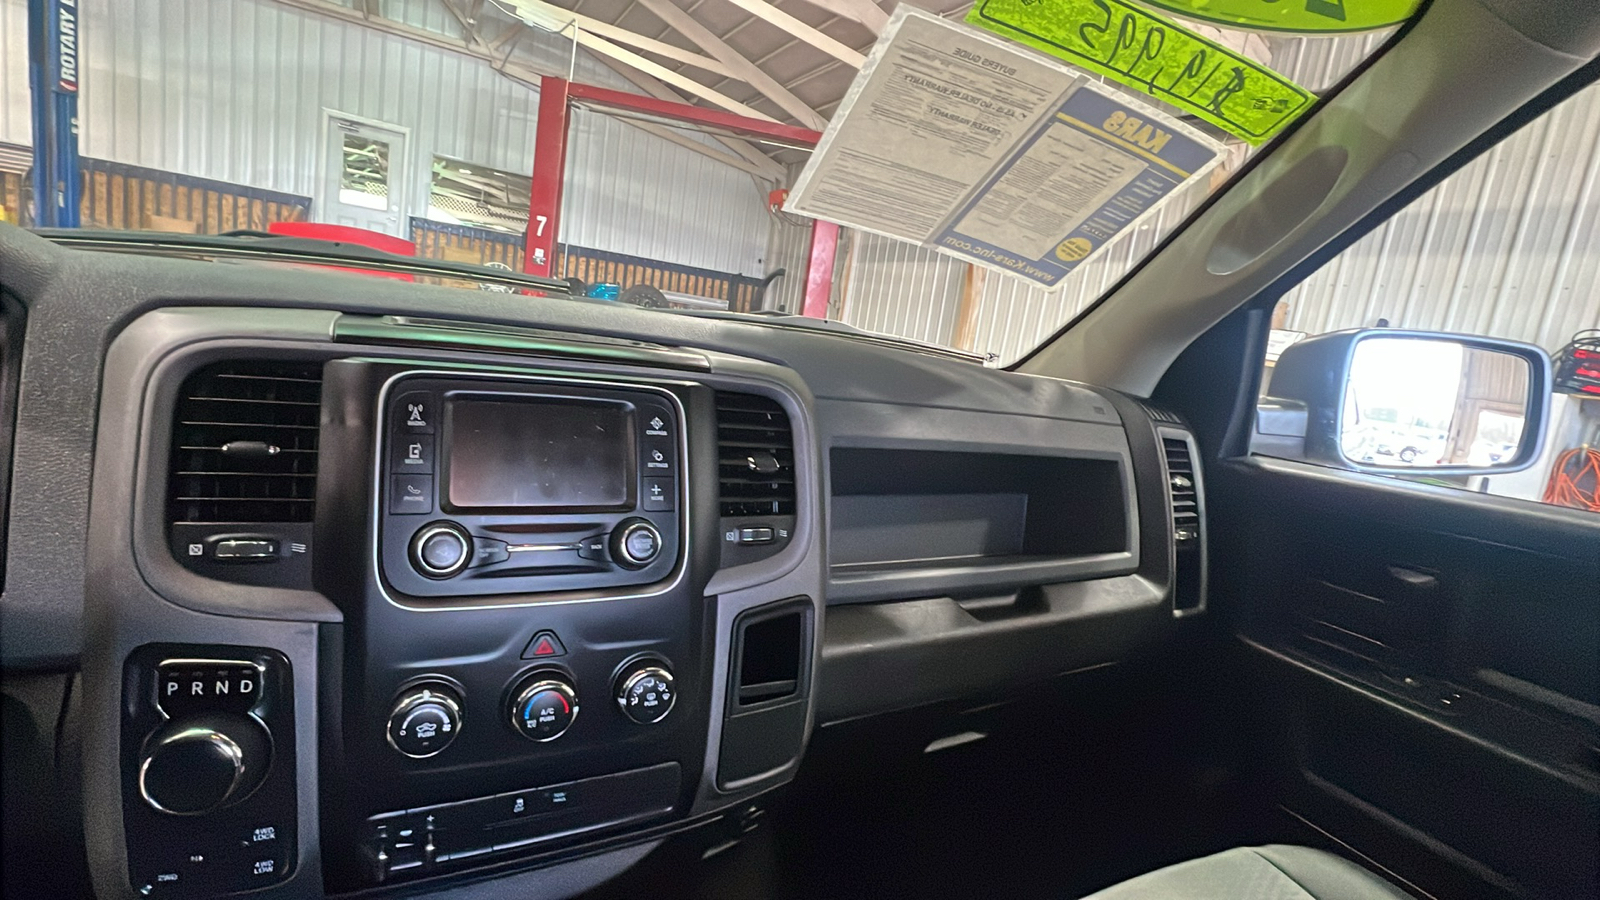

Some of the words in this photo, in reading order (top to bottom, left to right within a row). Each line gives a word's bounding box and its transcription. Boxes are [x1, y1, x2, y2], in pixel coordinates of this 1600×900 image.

[60, 8, 77, 82] ROTARY
[536, 215, 548, 237] 7
[167, 682, 179, 695] P
[191, 681, 204, 695] R
[215, 680, 229, 694] N
[240, 680, 253, 692] D
[253, 833, 275, 841] LOCK
